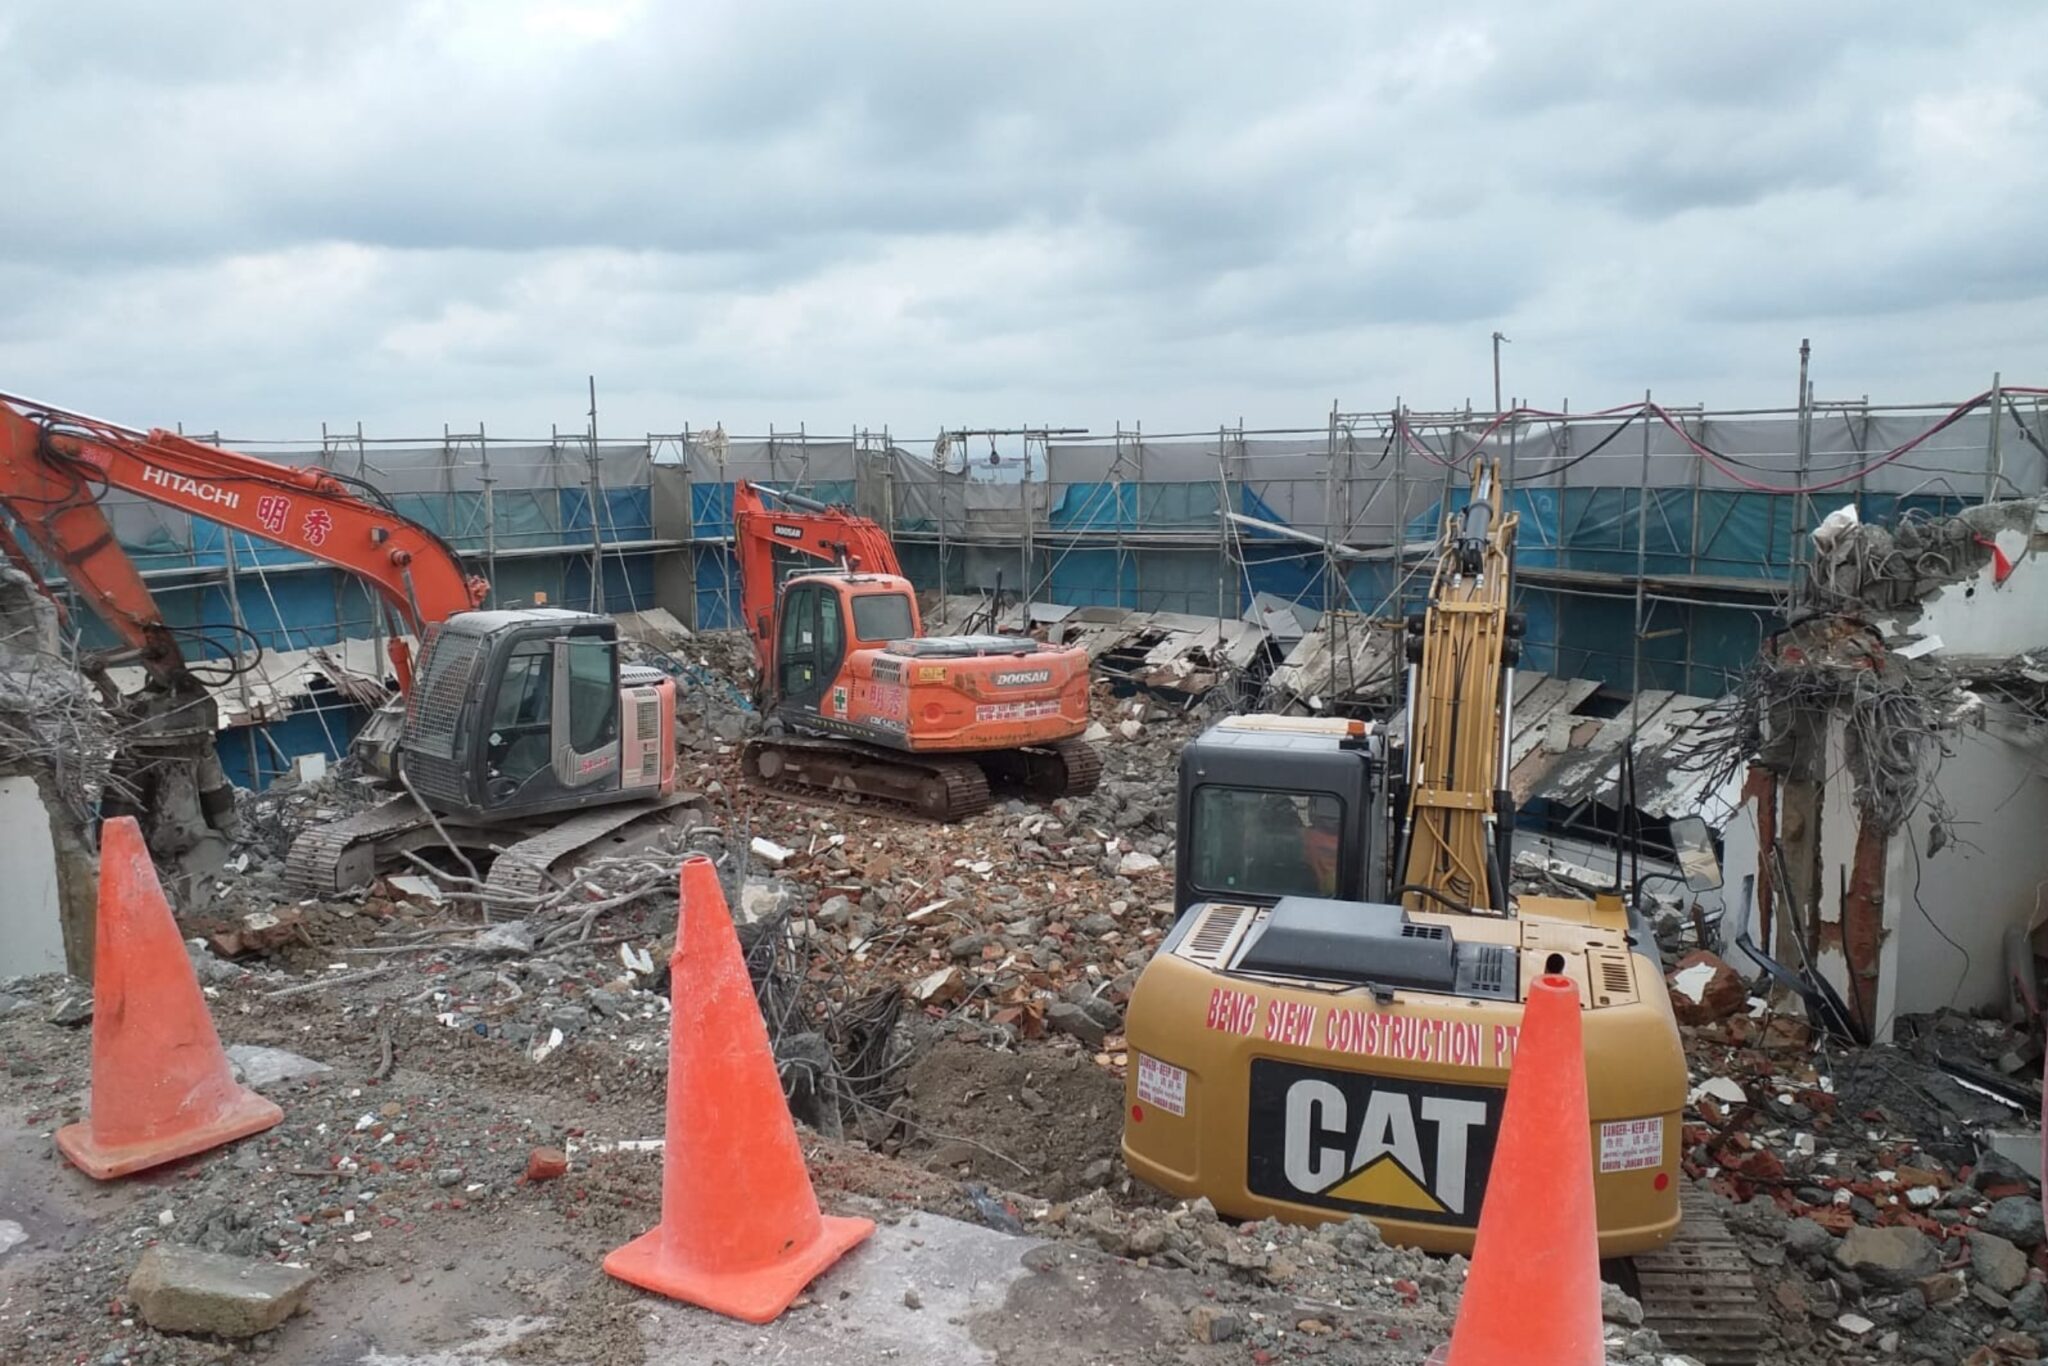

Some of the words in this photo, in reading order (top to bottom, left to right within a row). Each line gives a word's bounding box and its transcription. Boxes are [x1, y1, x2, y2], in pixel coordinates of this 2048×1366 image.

[143, 464, 241, 509] HITACHI
[774, 525, 801, 538] DOOSAN
[996, 671, 1049, 686] DOOSAN
[1206, 987, 1258, 1036] BENG
[1264, 999, 1317, 1047] SIEW
[1325, 1007, 1483, 1067] CONSTRUCTION
[1284, 1079, 1488, 1215] CAT
